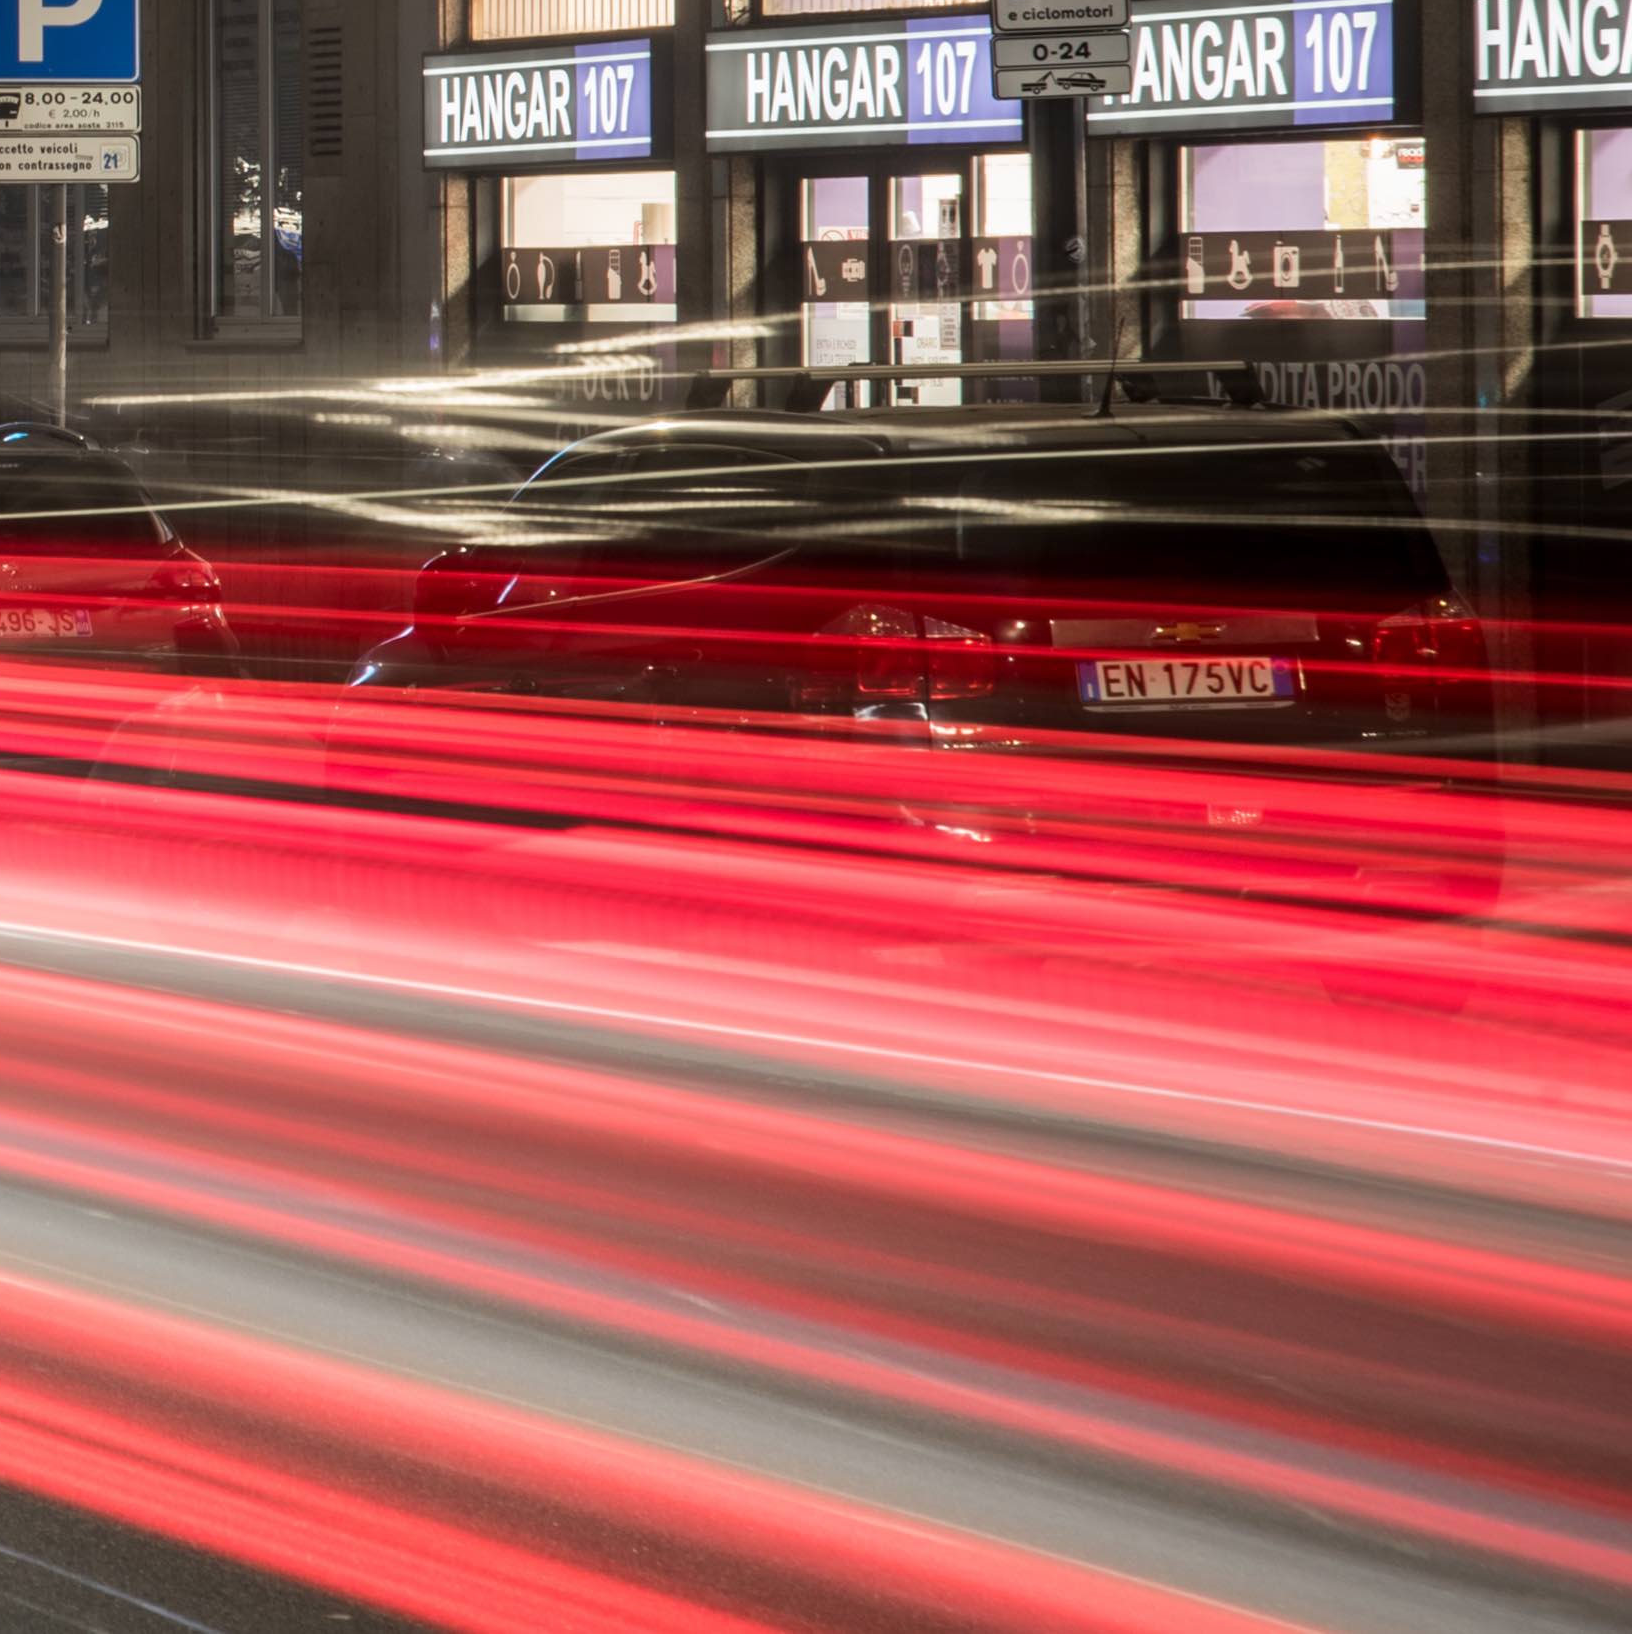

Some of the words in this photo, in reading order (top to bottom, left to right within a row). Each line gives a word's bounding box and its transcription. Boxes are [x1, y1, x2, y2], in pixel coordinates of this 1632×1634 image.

[1008, 12, 1018, 21] e
[1022, 5, 1113, 21] ciclomotori
[1032, 42, 1091, 61] 0-24
[1102, 16, 1288, 107] ANGAR
[1304, 10, 1378, 94] 107
[746, 43, 902, 124] HANGAR
[916, 40, 977, 117] 107
[24, 92, 66, 106] 8.00
[81, 92, 134, 106] 24.00
[439, 67, 572, 143] HANGAR
[583, 64, 635, 135] 107
[40, 143, 78, 154] veicoli
[18, 160, 93, 173] contrassegno
[103, 153, 119, 170] 21
[1102, 663, 1148, 699] EN
[1163, 659, 1270, 697] 175VC
